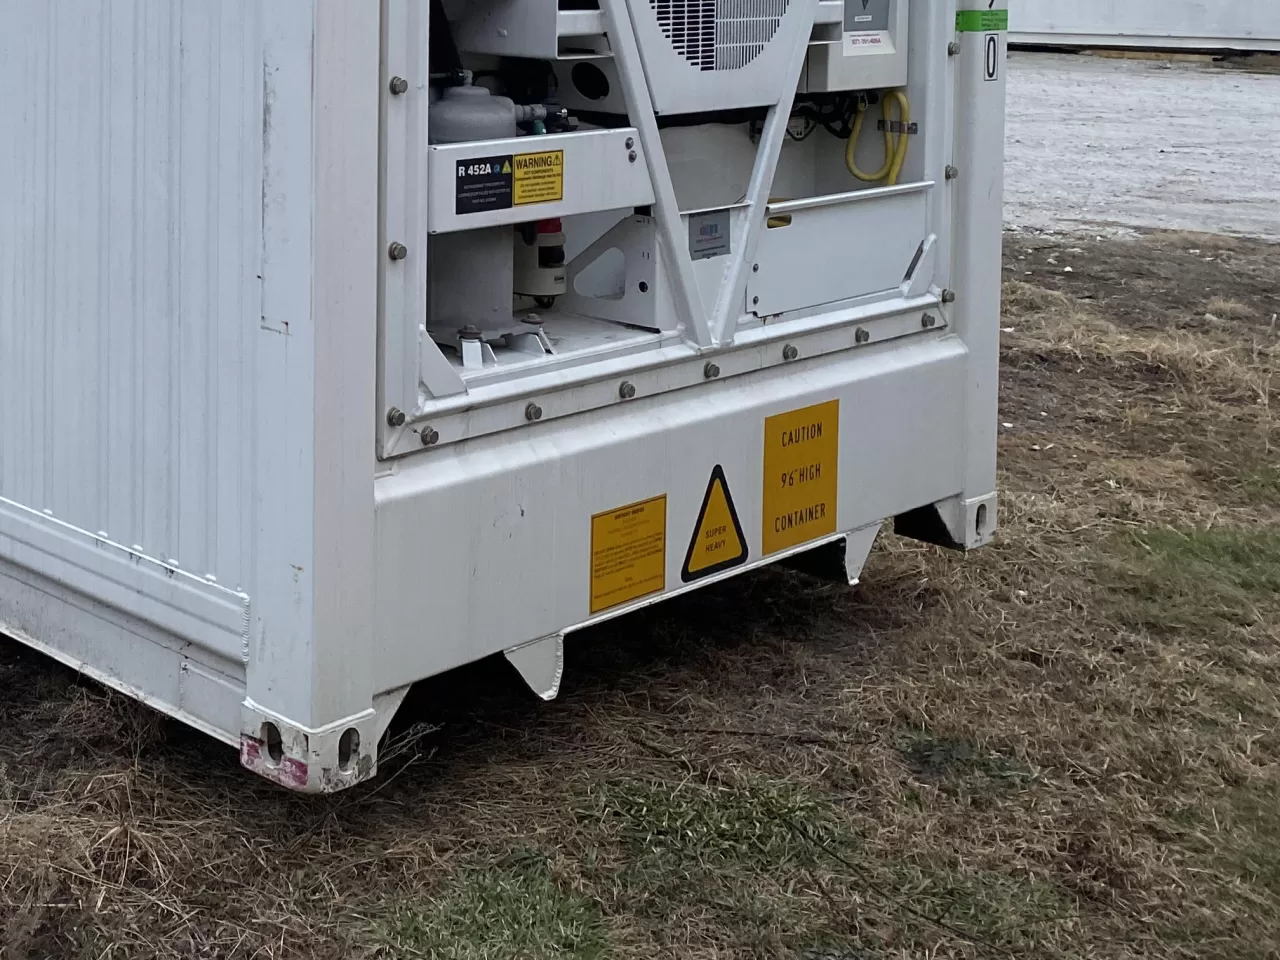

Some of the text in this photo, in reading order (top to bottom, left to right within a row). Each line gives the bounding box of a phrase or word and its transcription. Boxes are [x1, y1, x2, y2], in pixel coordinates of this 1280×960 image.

[986, 36, 996, 78] 0
[458, 163, 492, 177] R 452A
[516, 156, 552, 170] WARNING
[781, 421, 823, 447] CAUTION
[799, 463, 821, 483] HIGH
[774, 502, 826, 533] CONTAINER
[705, 525, 727, 539] SUPER
[705, 539, 726, 553] HEAVY
